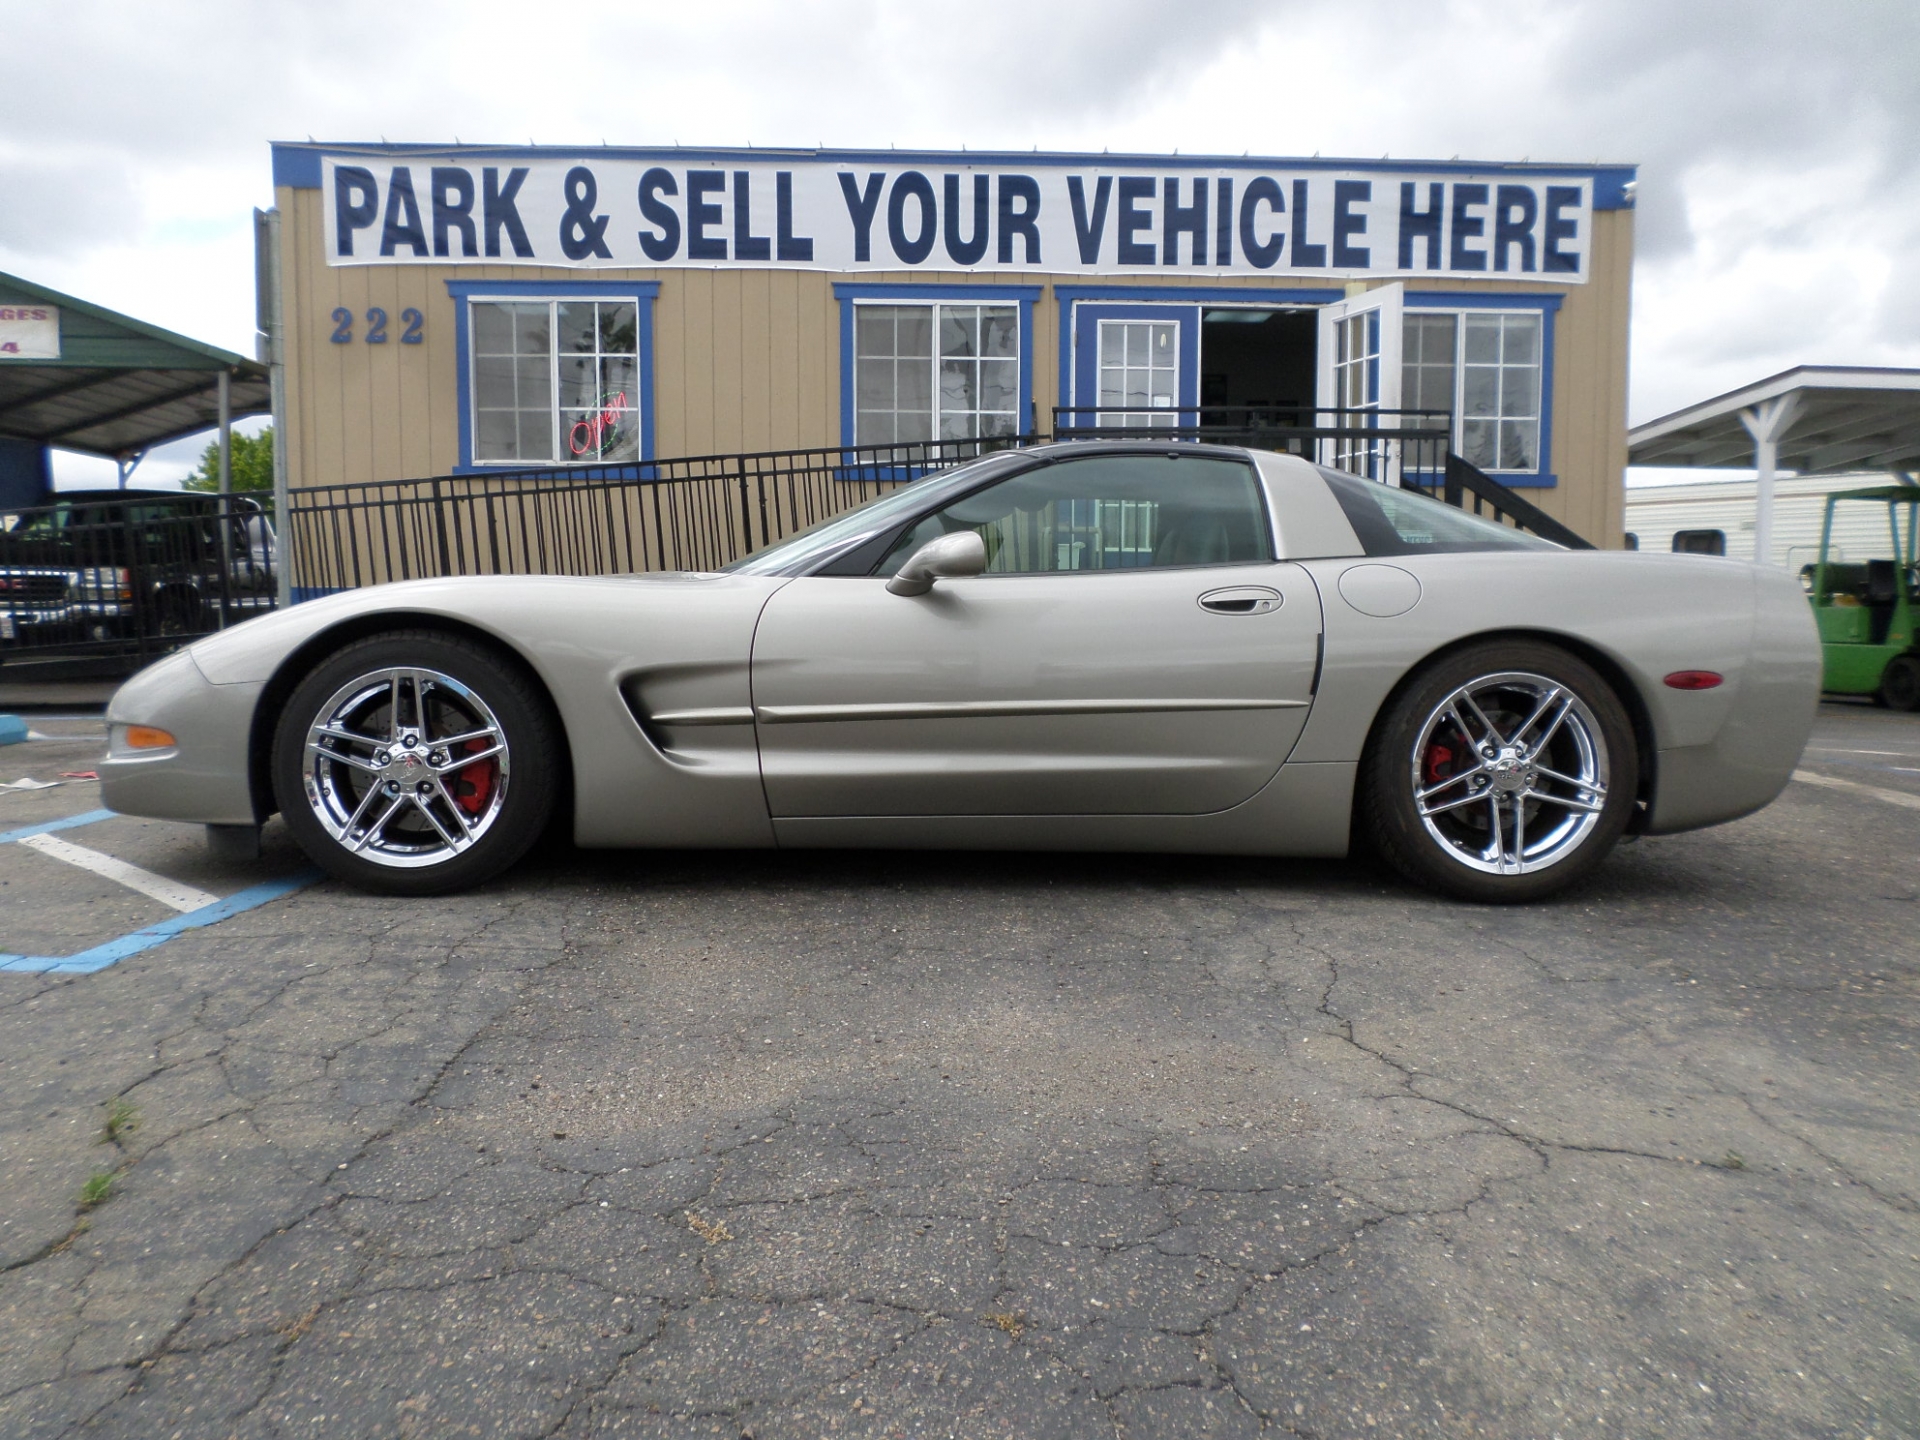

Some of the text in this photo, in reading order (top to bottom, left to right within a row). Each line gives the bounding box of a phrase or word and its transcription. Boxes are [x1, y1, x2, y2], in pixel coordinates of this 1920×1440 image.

[334, 166, 1582, 273] PARK & SELL YOUR VEHICLE HERE
[329, 307, 423, 344] 222
